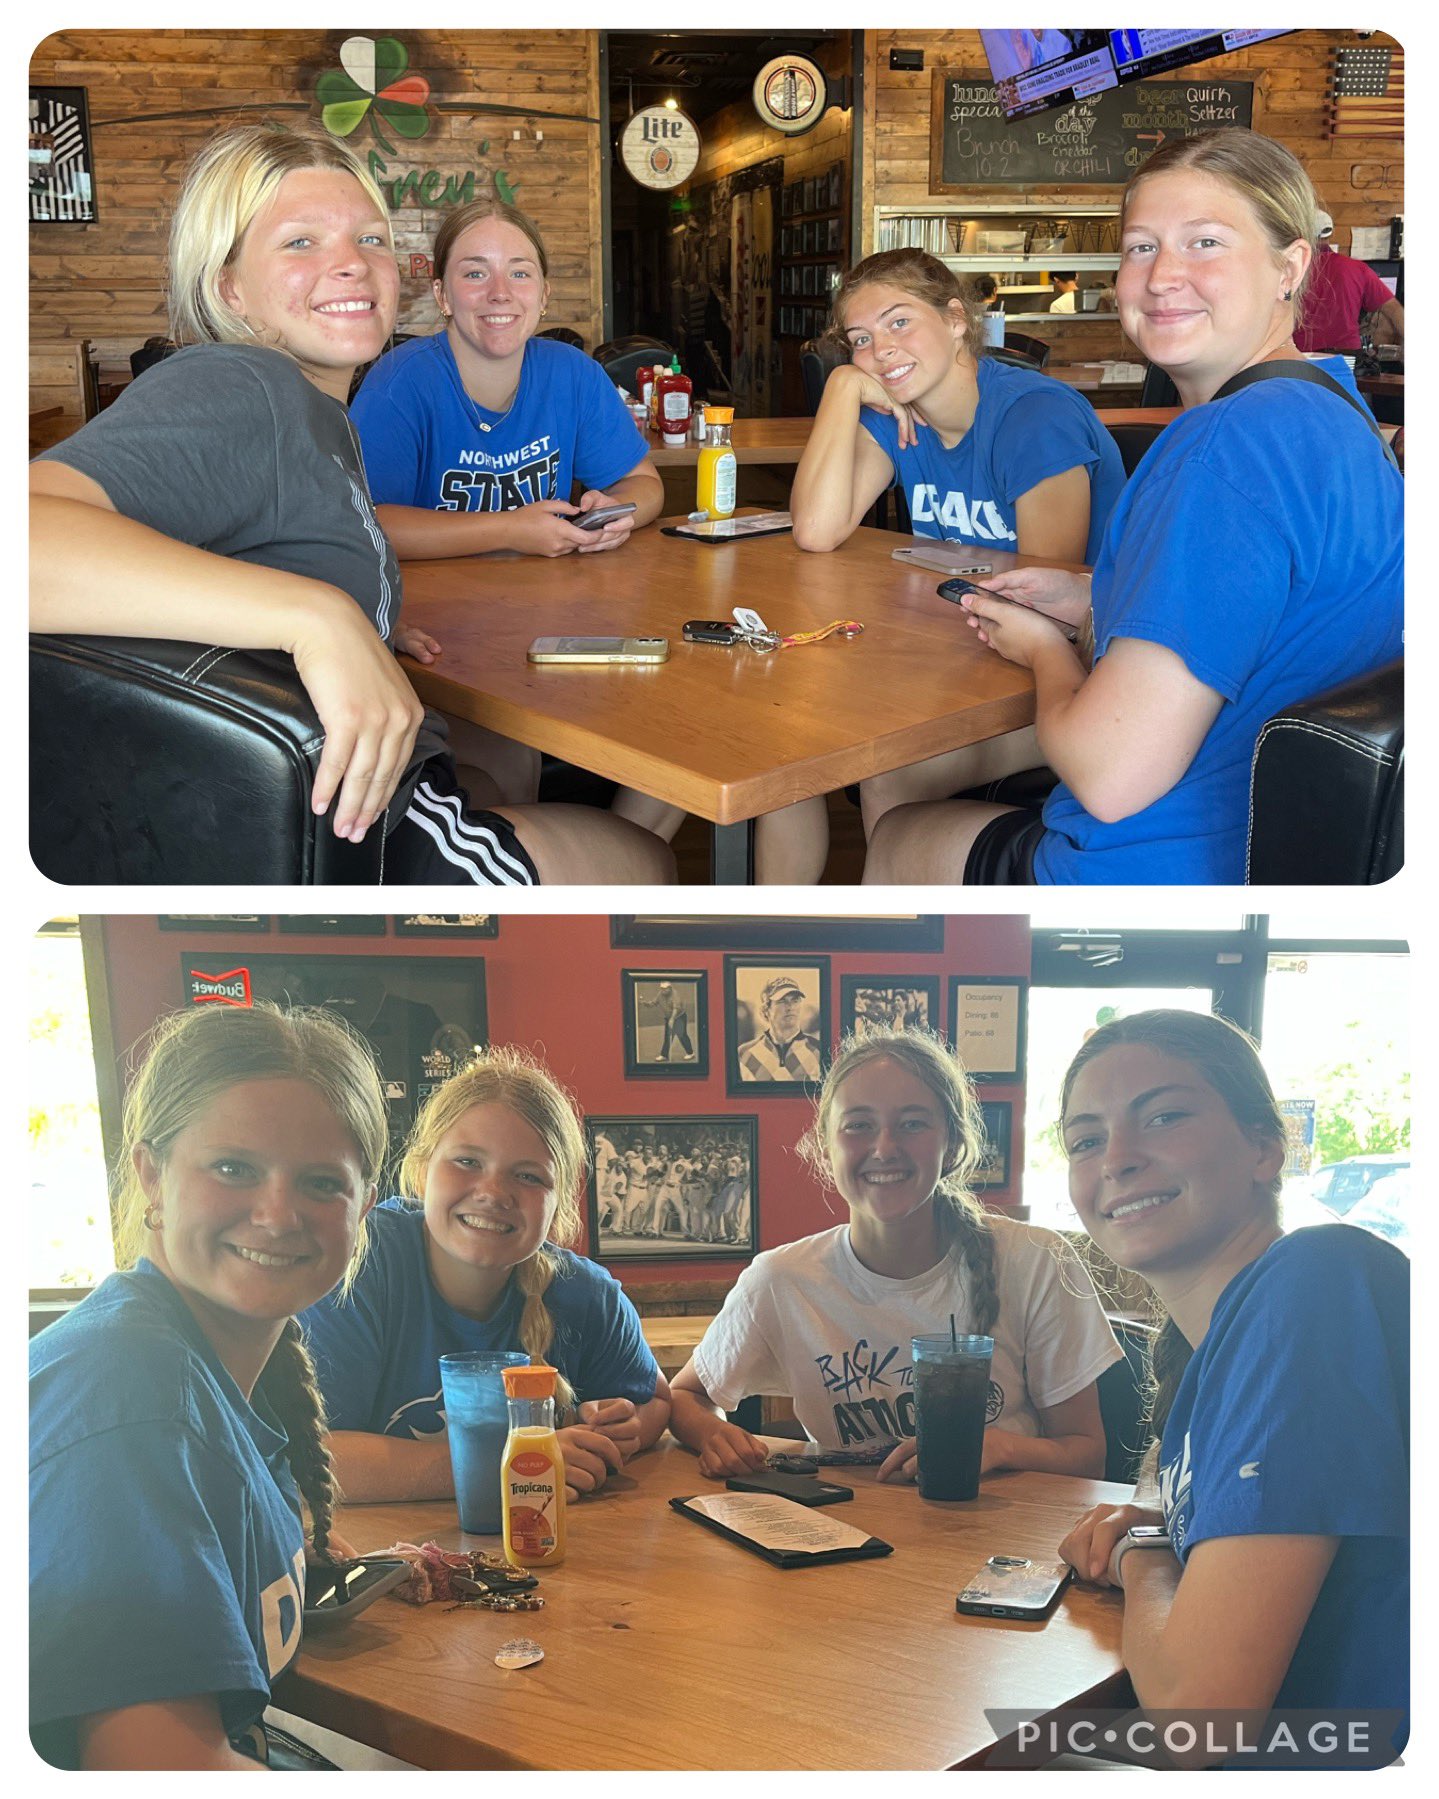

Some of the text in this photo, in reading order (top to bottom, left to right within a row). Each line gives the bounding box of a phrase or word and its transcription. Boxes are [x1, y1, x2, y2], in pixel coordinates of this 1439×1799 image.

[952, 83, 1000, 104] lunc
[1186, 86, 1231, 103] Quirk
[950, 104, 1002, 126] specia
[1079, 105, 1094, 117] the
[1122, 110, 1190, 129] month
[1189, 105, 1239, 122] Seltzer
[641, 116, 683, 144] Lite
[1055, 113, 1098, 136] day
[957, 127, 1020, 158] Brunch
[1037, 132, 1088, 145] Broccoli
[1054, 159, 1070, 175] OR
[1072, 156, 1111, 175] CHILI
[436, 448, 561, 513] STATE
[965, 993, 1003, 1002] Occupancy
[424, 1069, 451, 1078] SERIES
[815, 1339, 899, 1402] BACK
[510, 1481, 553, 1496] Tropicana
